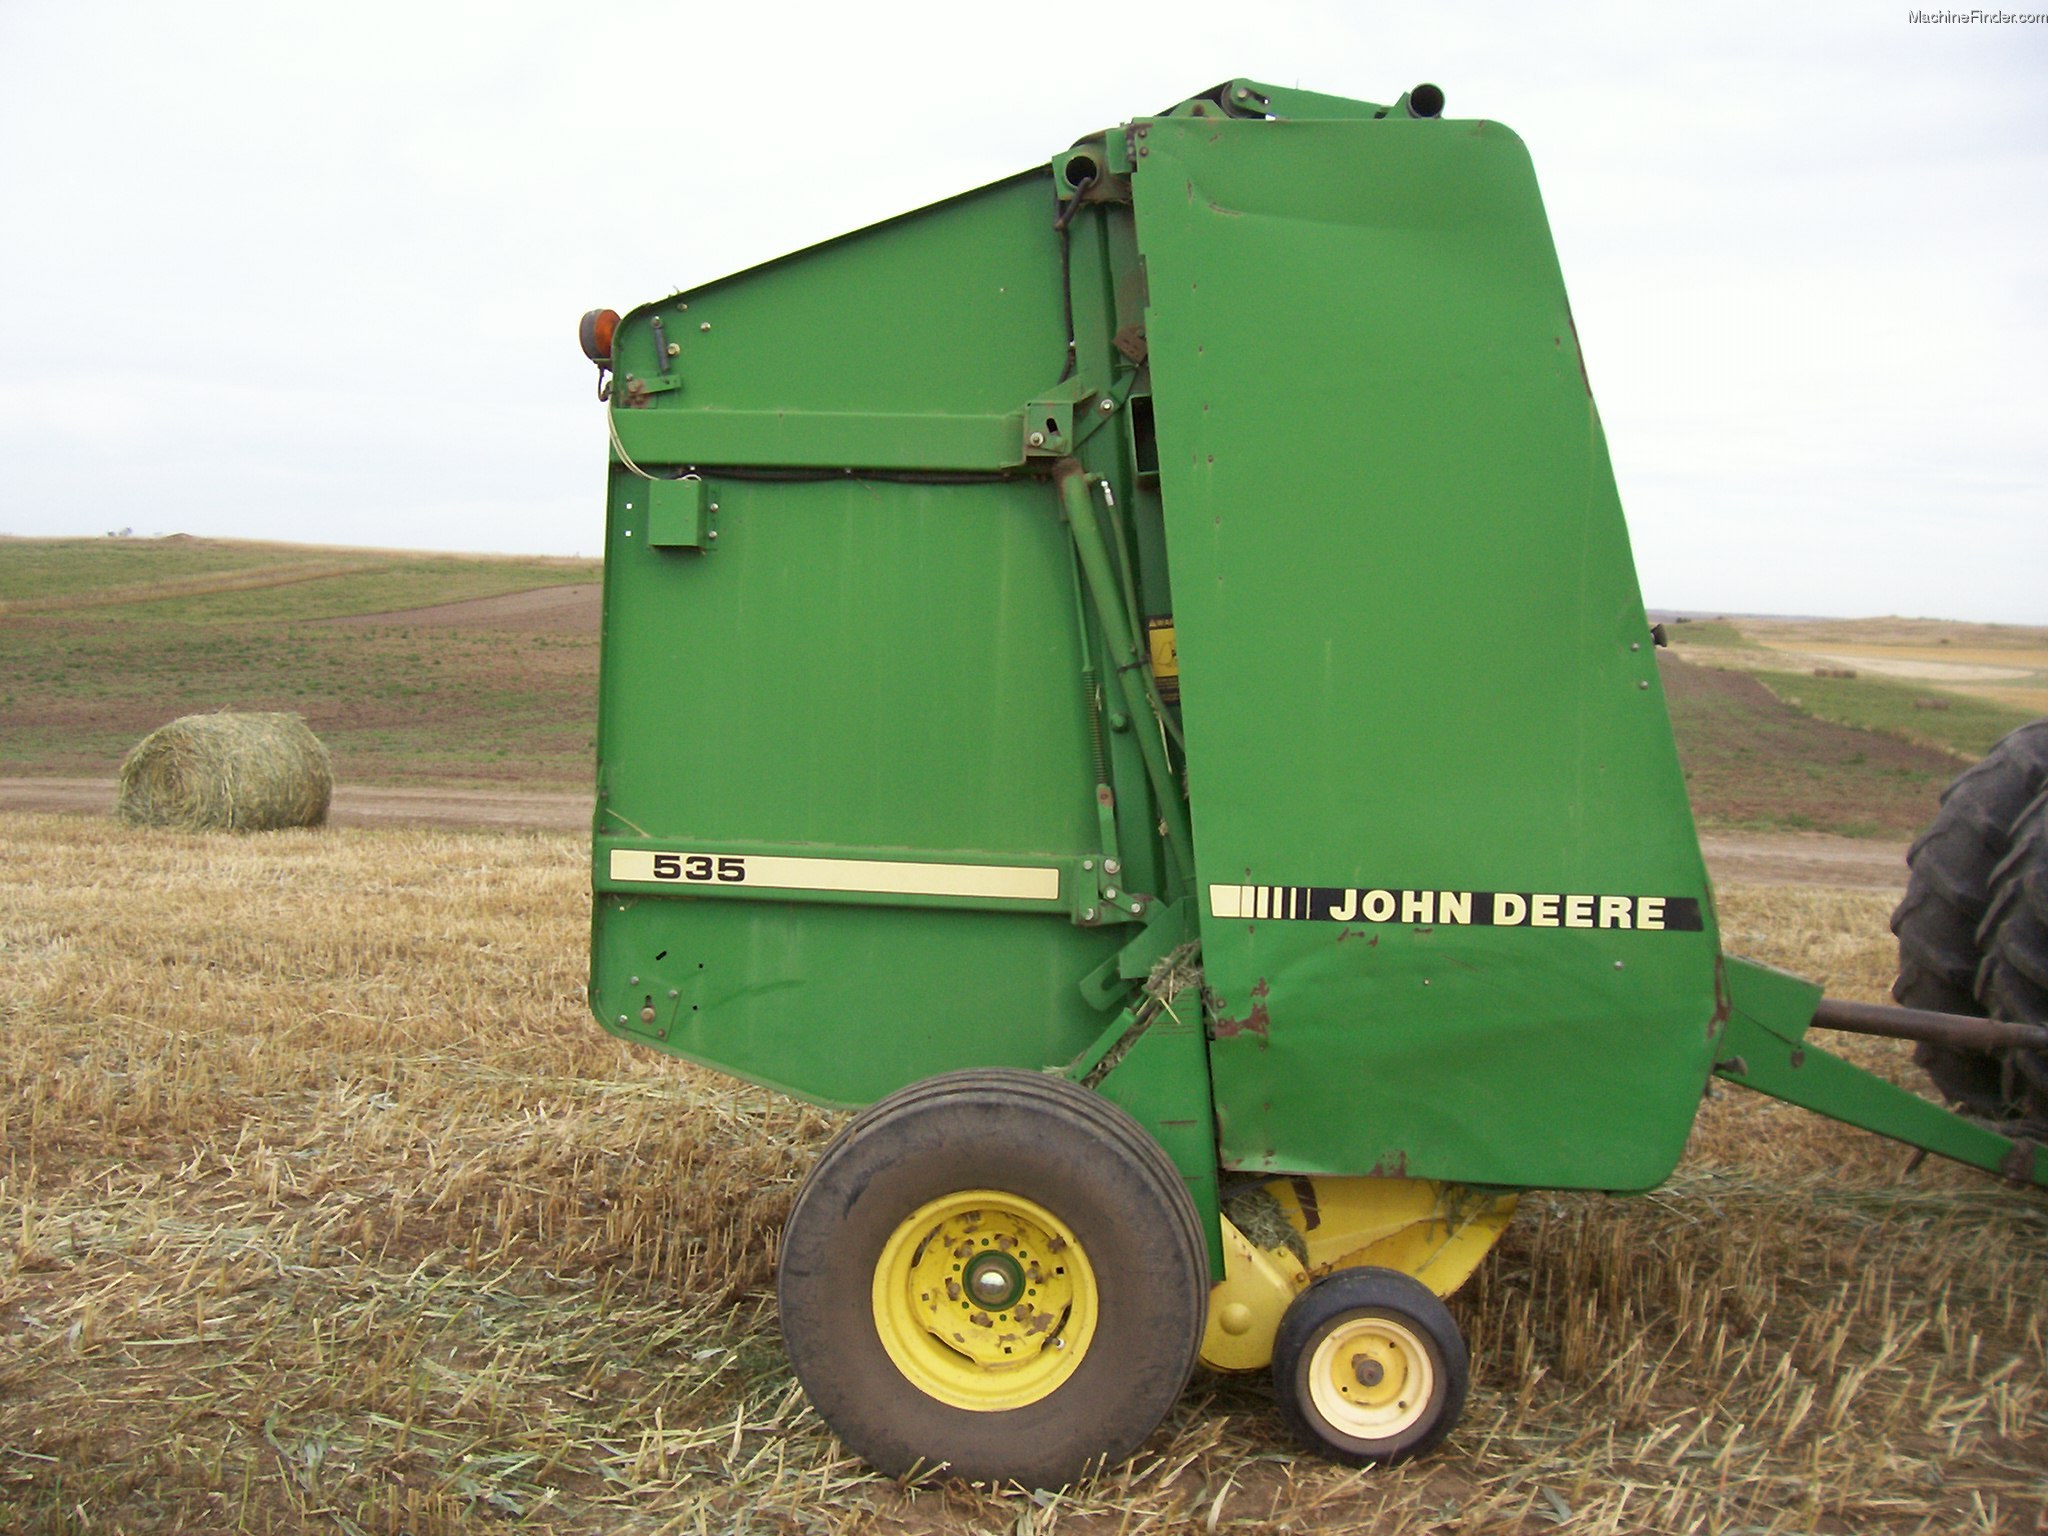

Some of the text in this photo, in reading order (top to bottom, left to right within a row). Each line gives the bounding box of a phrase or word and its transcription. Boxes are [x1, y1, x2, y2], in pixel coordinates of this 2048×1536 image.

[654, 855, 745, 882] 535
[1330, 889, 1666, 930] JOHN DEERE
